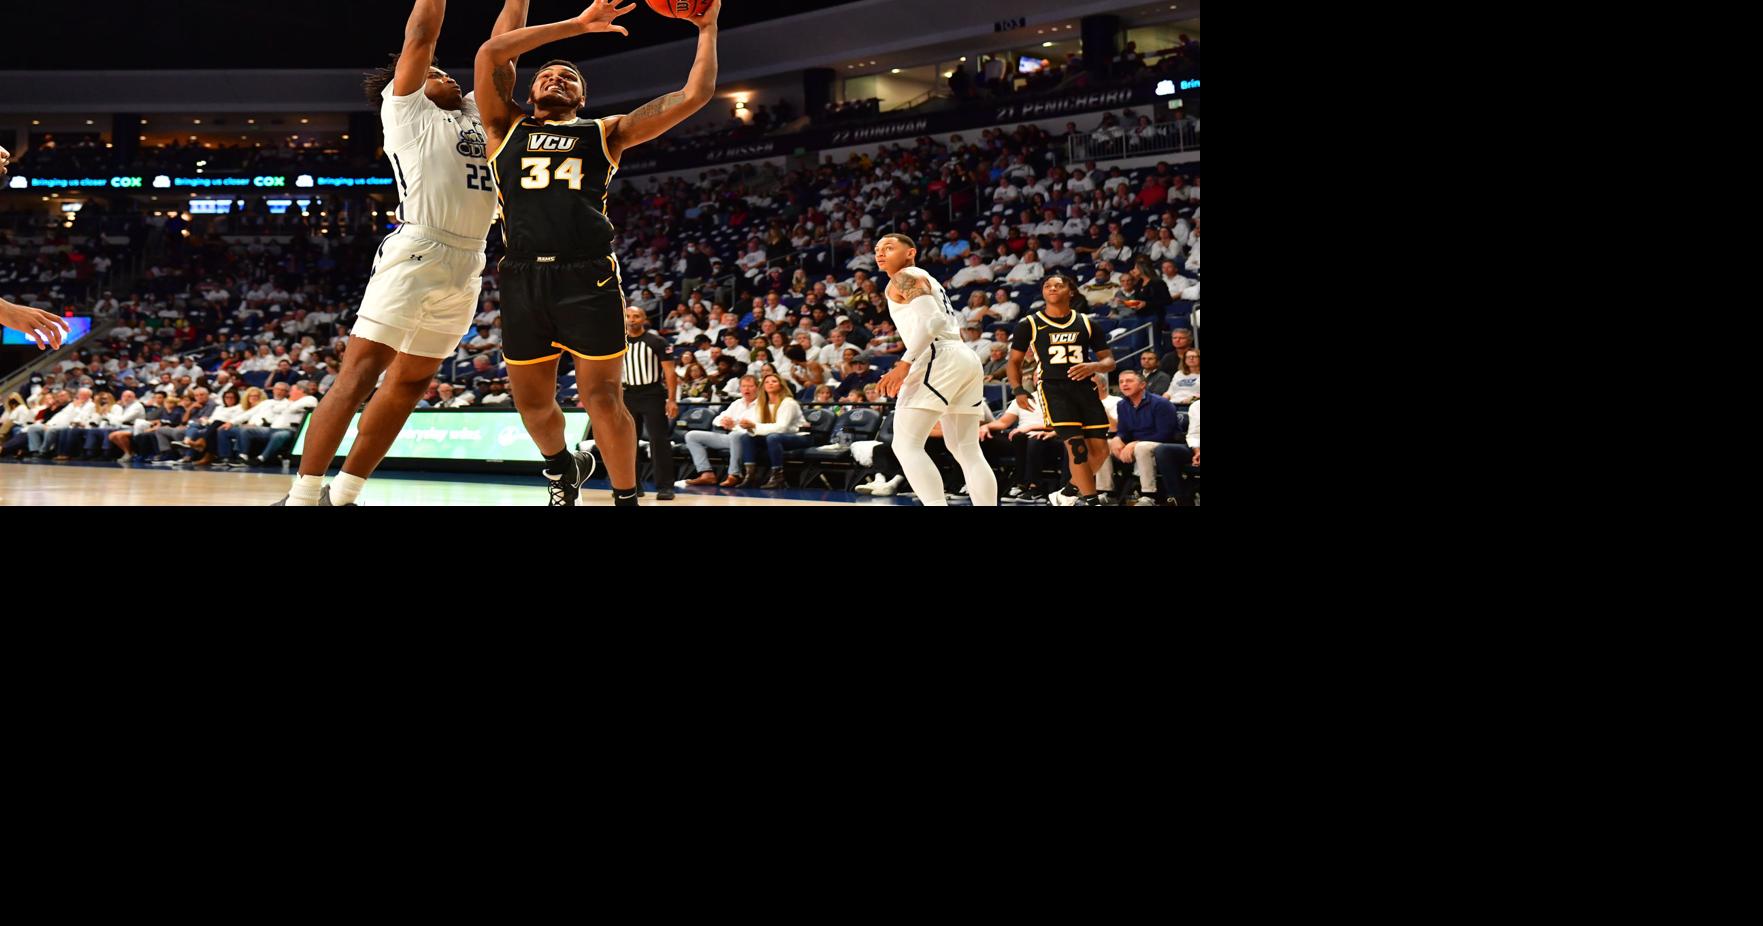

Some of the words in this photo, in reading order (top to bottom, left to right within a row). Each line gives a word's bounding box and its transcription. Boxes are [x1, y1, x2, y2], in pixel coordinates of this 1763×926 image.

[997, 107, 1015, 120] 21
[854, 118, 927, 140] DONOVAN
[528, 134, 577, 151] VCU
[466, 163, 492, 192] 22
[520, 157, 584, 190] 34
[31, 177, 68, 188] Bringing
[68, 178, 79, 187] us
[80, 177, 107, 187] closer
[110, 176, 142, 188] COX
[174, 176, 211, 187] Bringing
[211, 178, 222, 186] us
[223, 176, 250, 186] closer
[253, 176, 285, 187] COX
[317, 176, 354, 187] Bringing
[354, 177, 365, 186] us
[366, 176, 393, 186] closer
[1050, 332, 1079, 344] VCU
[1048, 345, 1083, 364] 23
